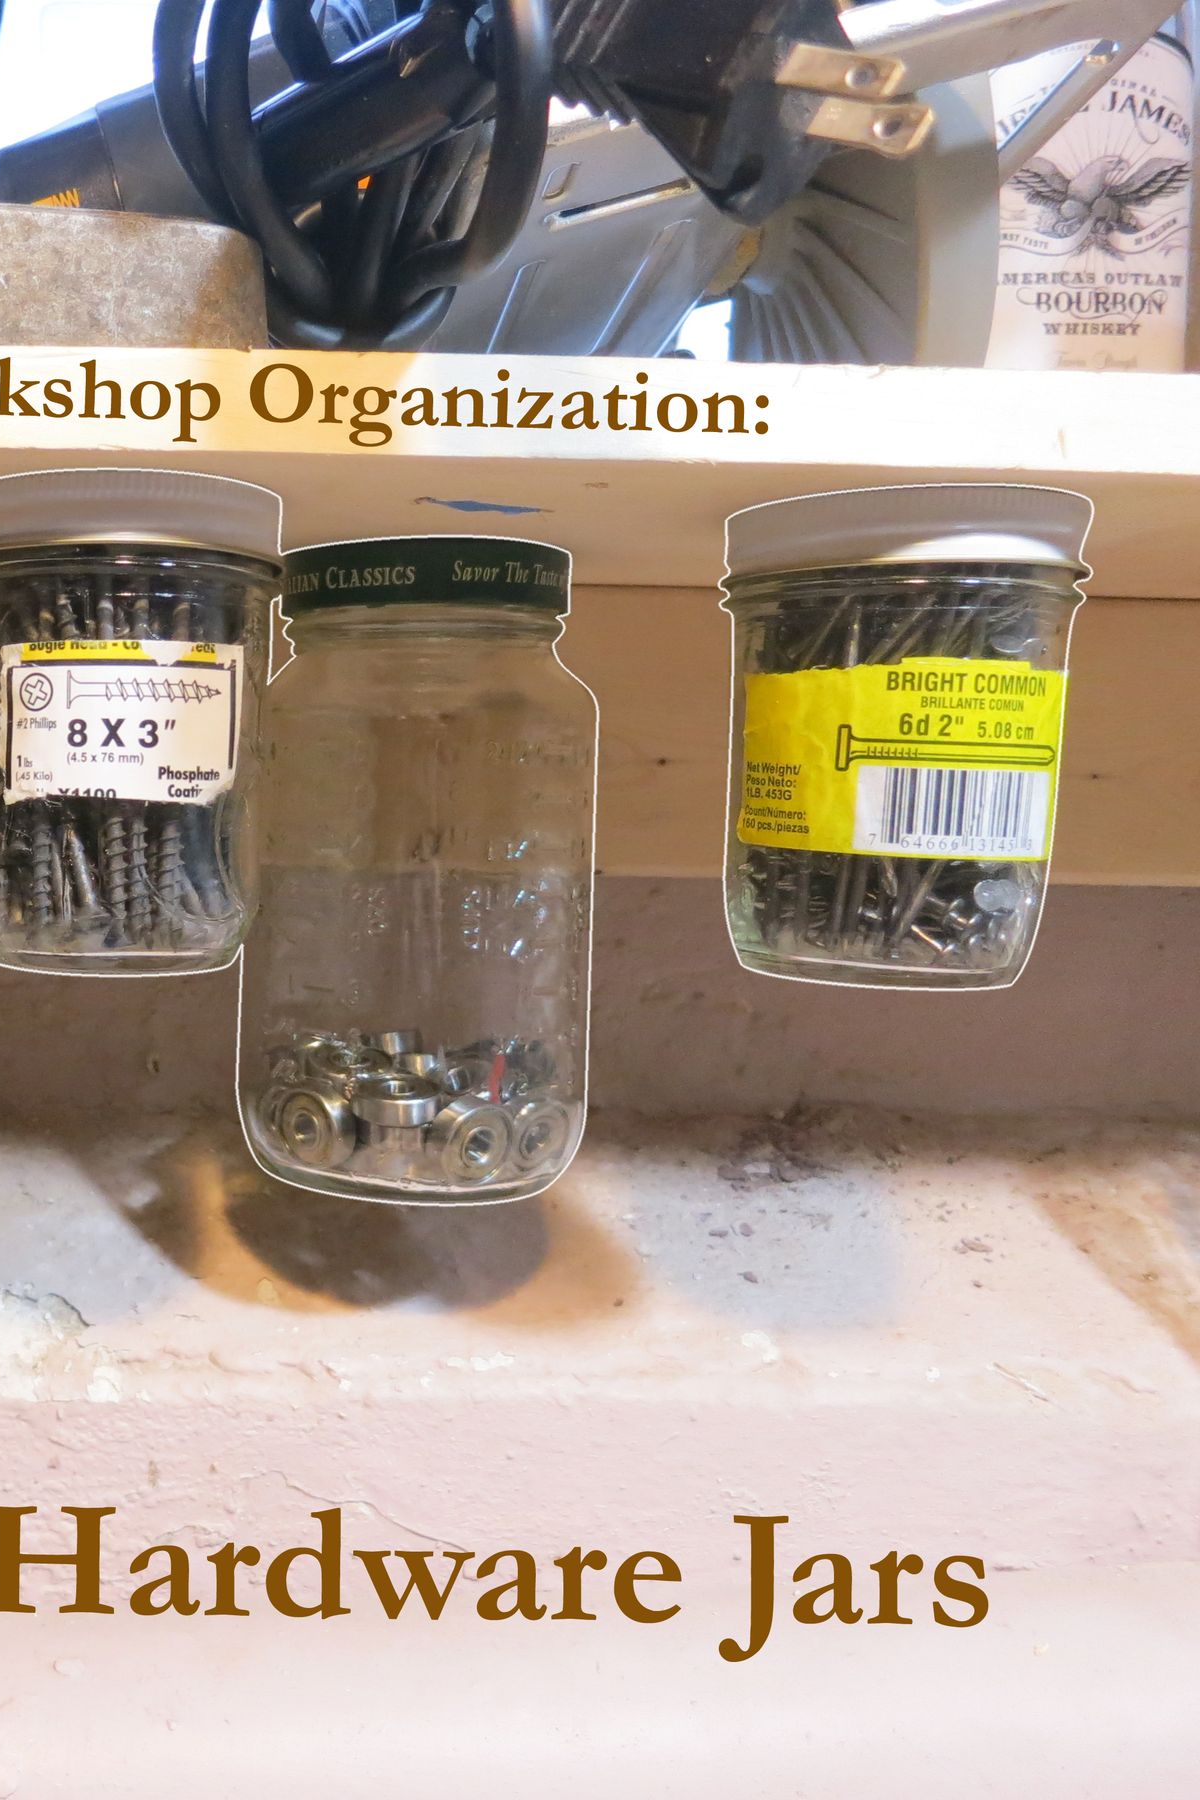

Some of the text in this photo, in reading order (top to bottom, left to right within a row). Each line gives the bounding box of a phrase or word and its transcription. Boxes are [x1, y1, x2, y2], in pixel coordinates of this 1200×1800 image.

[1108, 91, 1191, 146] JAMES
[1104, 273, 1184, 287] OUTLAW
[1035, 290, 1166, 316] BOURBON
[1043, 322, 1143, 336] WHISKEY
[325, 566, 415, 590] CLASSICS
[452, 560, 499, 583] Savor
[505, 561, 528, 584] The
[886, 671, 1047, 697] BRIGHT COMMON
[920, 695, 1025, 711] BRILLANTE COMUN
[16, 718, 58, 730] #2 Phillips
[898, 713, 930, 737] 6d
[977, 721, 1012, 740] 5.08
[1016, 726, 1035, 741] cm
[67, 718, 89, 748] 8
[100, 718, 126, 748] X
[66, 753, 88, 765] (4.5
[101, 753, 115, 764] 76
[118, 753, 145, 766] mm)
[746, 761, 760, 773] Net
[32, 771, 54, 783] Kilo)
[158, 766, 221, 783] Phosphate
[745, 774, 797, 788] Peso Neto:
[167, 784, 203, 798] Coati
[765, 788, 792, 801] 453G
